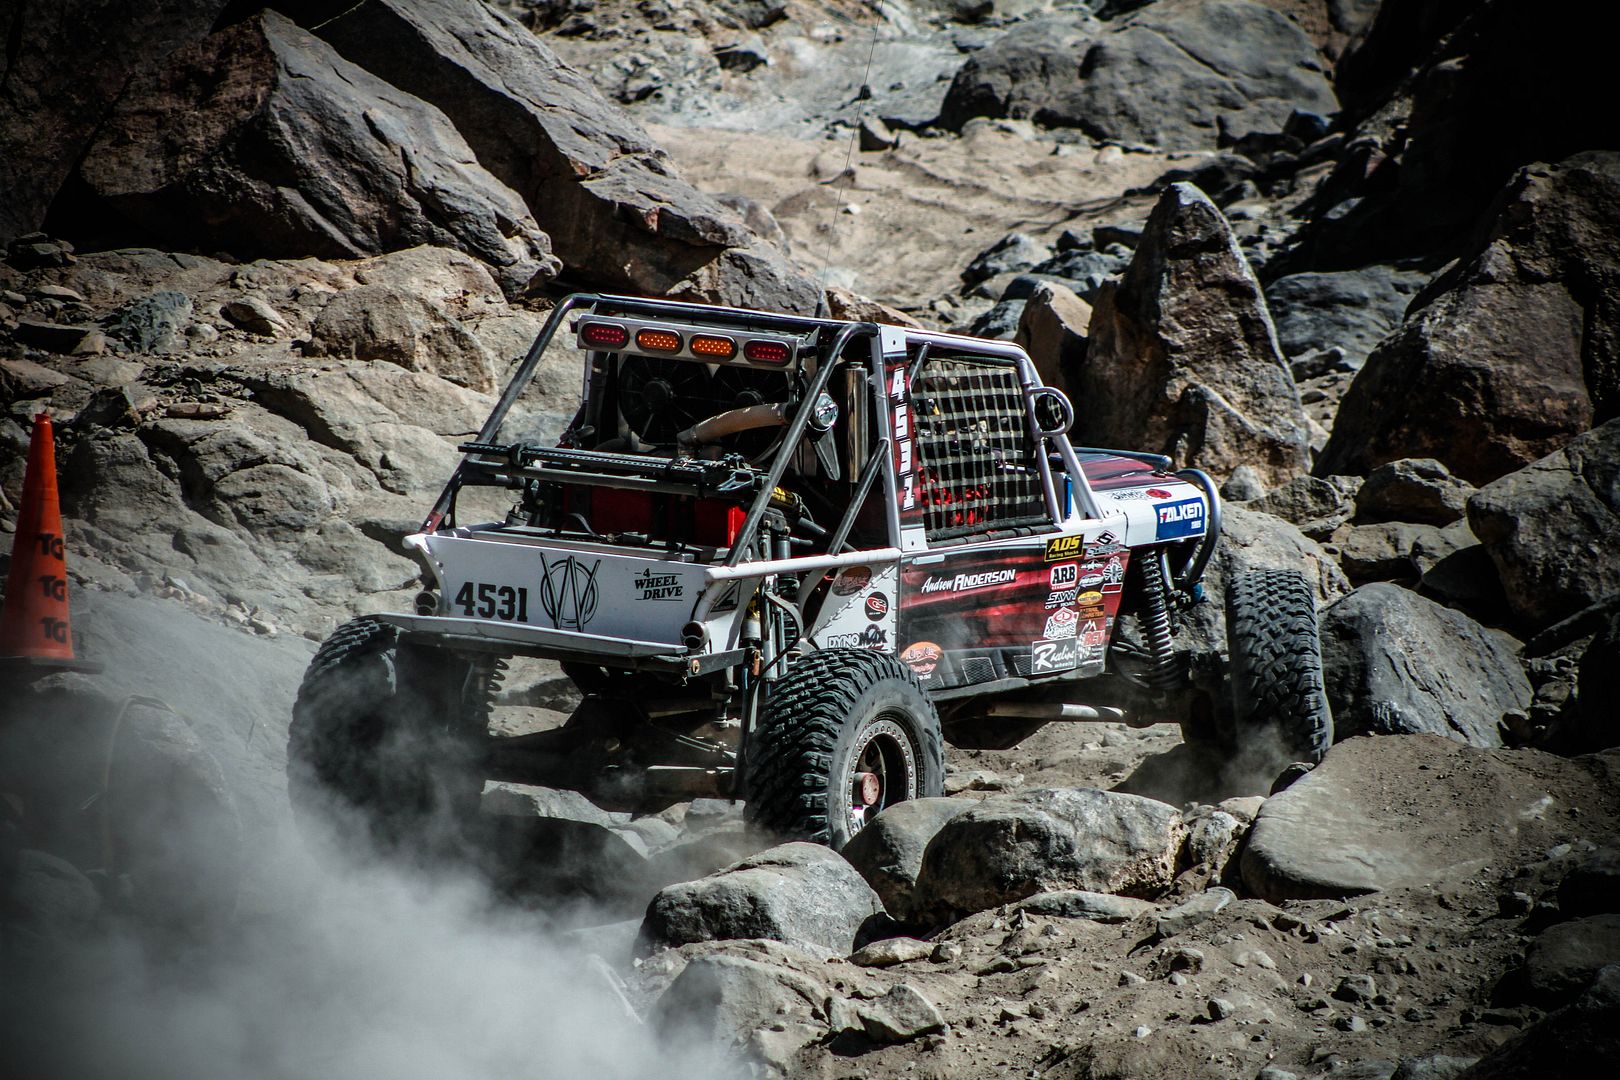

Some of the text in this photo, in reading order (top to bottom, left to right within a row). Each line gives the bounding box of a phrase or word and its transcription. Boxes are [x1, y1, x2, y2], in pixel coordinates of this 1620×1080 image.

[1159, 502, 1203, 524] FALKEN
[35, 533, 64, 561] TG
[1048, 535, 1082, 553] ADS
[634, 575, 679, 590] WHEEL
[642, 567, 650, 578] 4
[921, 568, 1016, 594] Andrew ANDERSON
[1052, 565, 1076, 585] ARB
[38, 575, 66, 602] TG
[642, 585, 684, 600] DRIVE
[455, 581, 528, 623] 4531
[41, 617, 67, 644] TG
